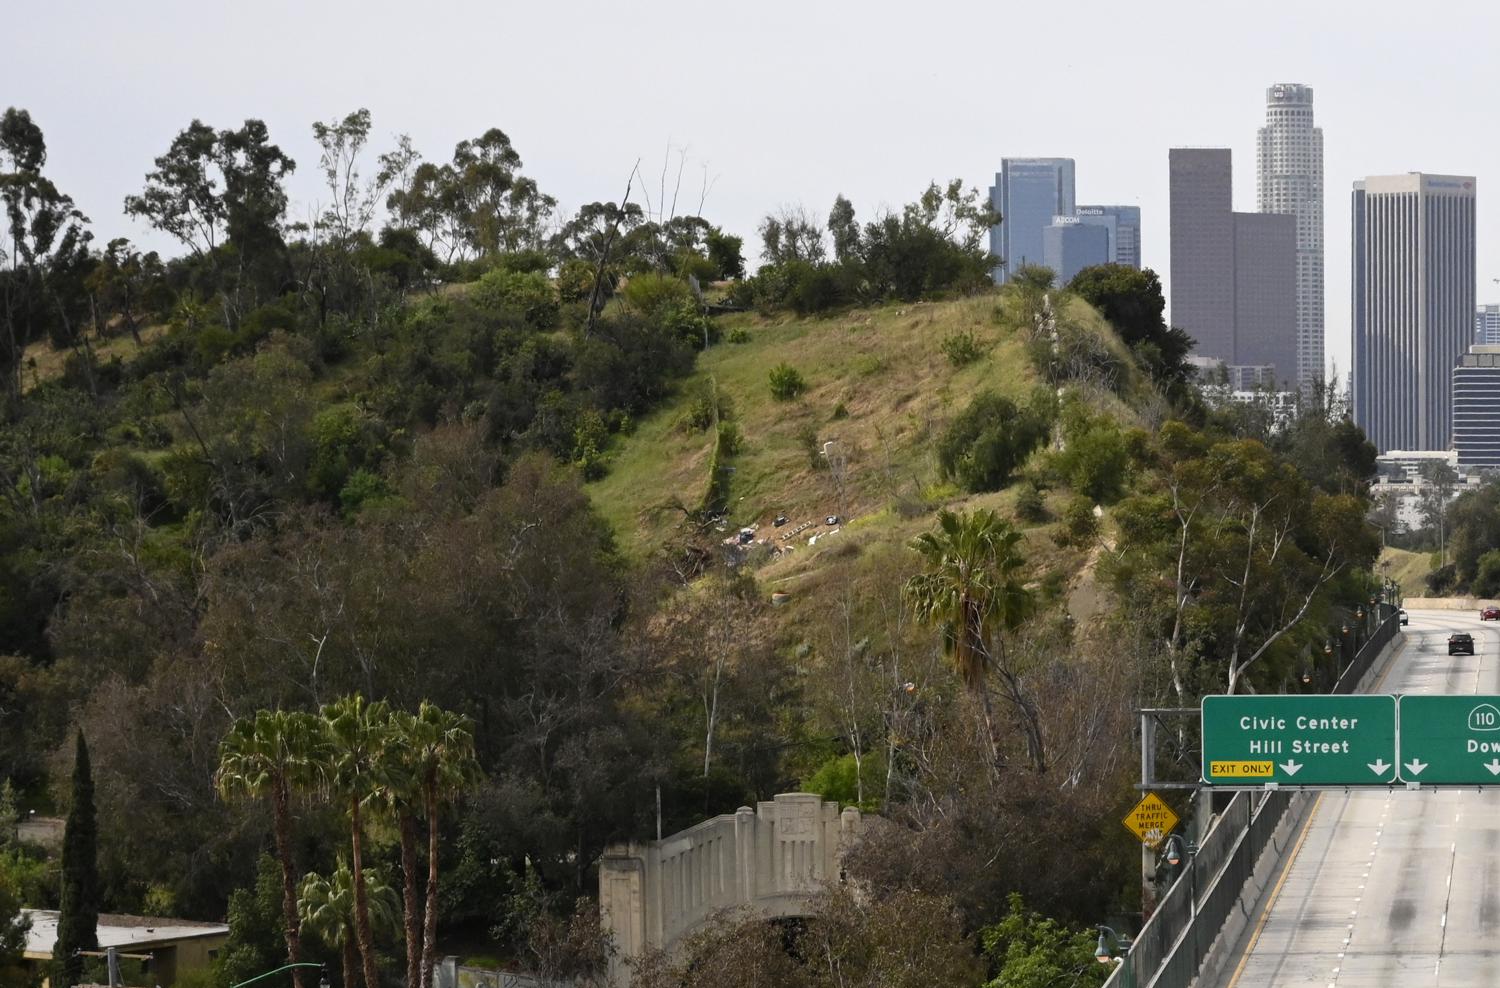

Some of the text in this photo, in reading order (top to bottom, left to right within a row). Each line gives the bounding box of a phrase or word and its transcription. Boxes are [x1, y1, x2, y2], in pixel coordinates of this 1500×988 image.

[1056, 216, 1080, 224] AECOM
[1240, 716, 1358, 730] Civic Center
[1475, 712, 1495, 726] 110
[1250, 740, 1349, 754] Hill Street
[1212, 764, 1272, 773] EXIT ONLY
[1141, 803, 1162, 811] THRU
[1136, 812, 1168, 820] TRAFFIC
[1139, 821, 1164, 829] MERGE
